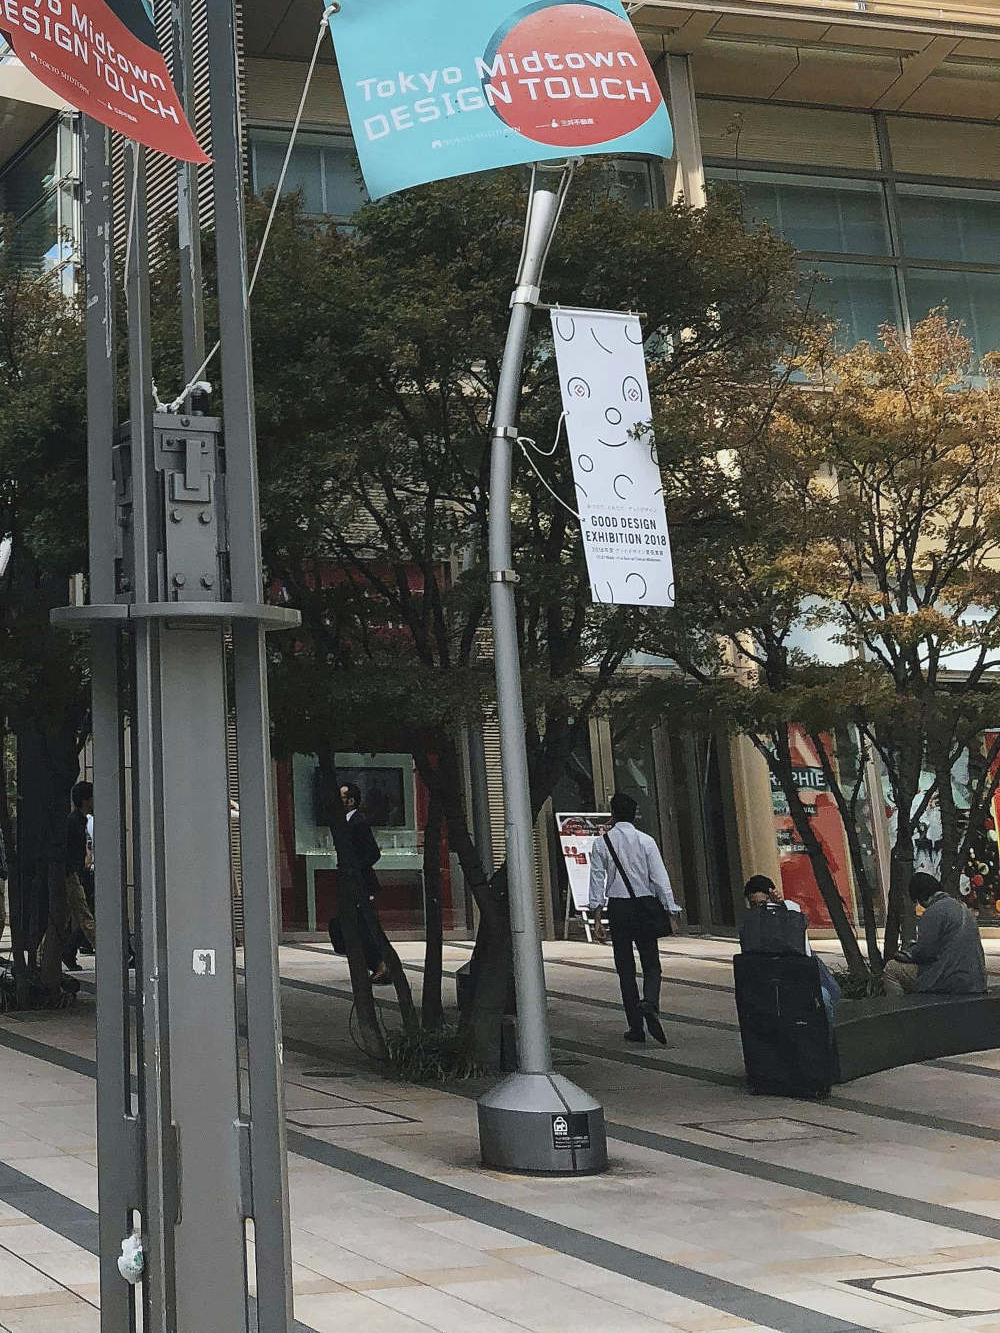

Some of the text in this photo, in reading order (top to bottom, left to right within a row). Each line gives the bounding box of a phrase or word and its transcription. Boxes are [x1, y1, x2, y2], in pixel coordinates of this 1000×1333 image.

[71, 2, 167, 91] Midtown
[356, 49, 638, 101] Tokyo Midtown
[91, 52, 180, 125] TOUCH
[363, 77, 652, 141] DESIGN TOUCH
[585, 530, 667, 546] EXHIBITION 2018
[591, 515, 657, 530] GOOD DESIGN
